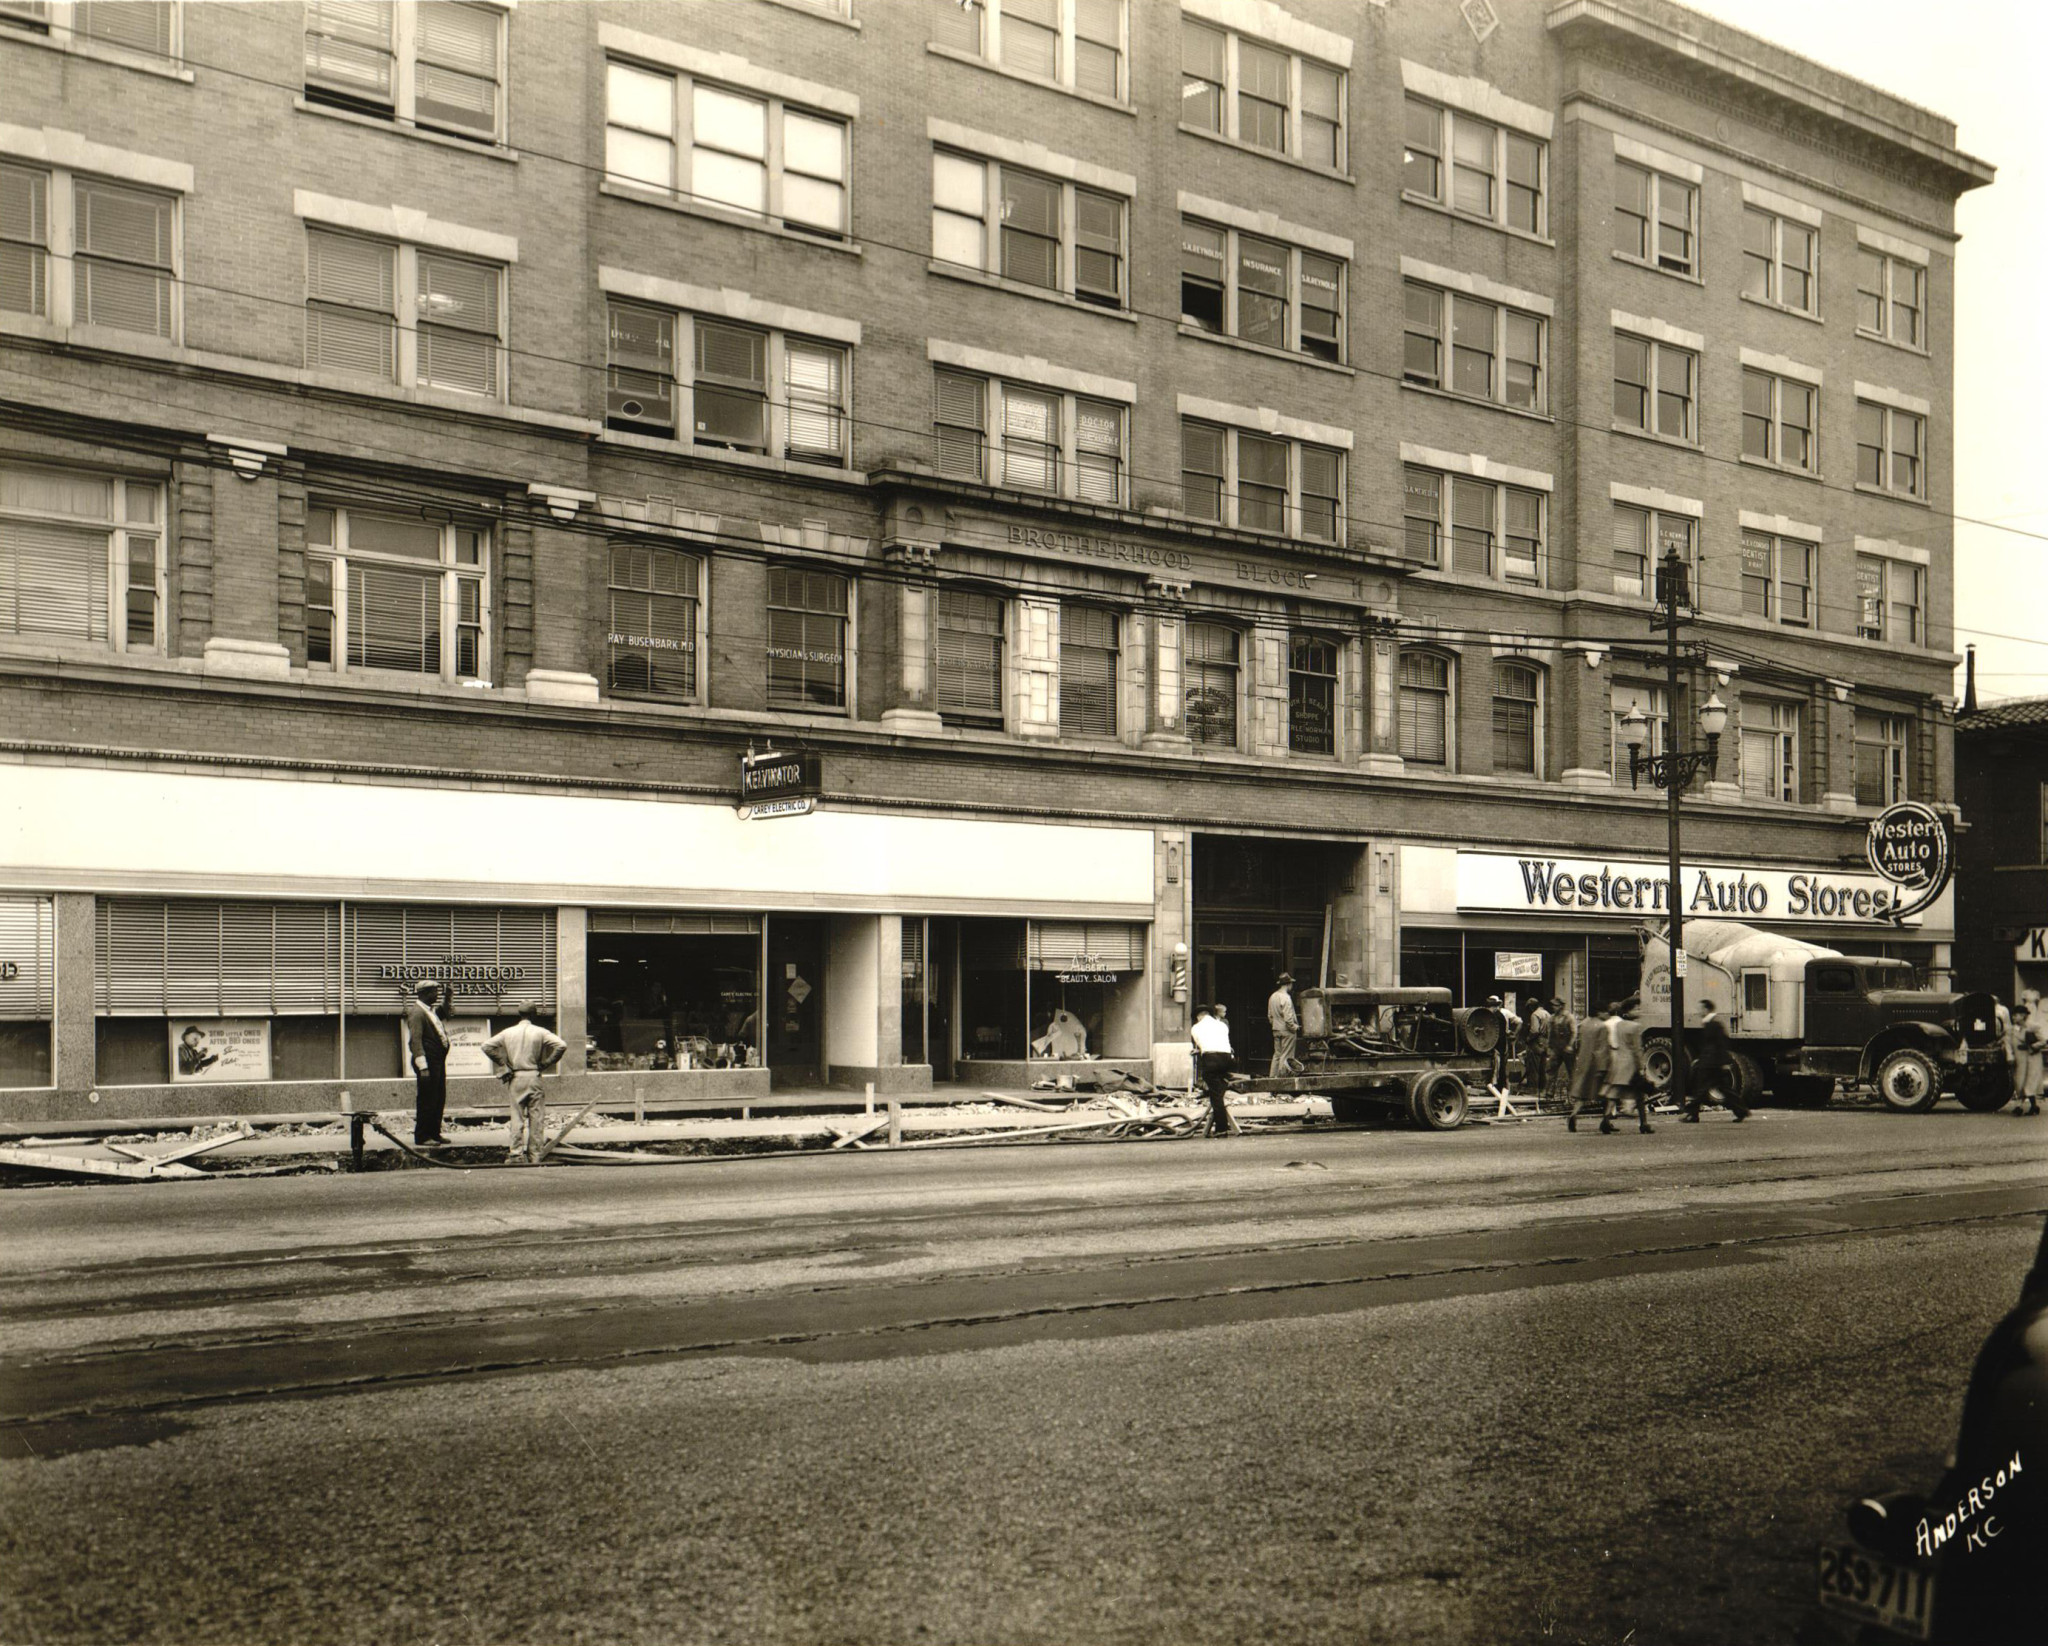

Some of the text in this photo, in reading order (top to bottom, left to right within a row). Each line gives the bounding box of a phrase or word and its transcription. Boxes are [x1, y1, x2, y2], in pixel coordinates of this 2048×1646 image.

[1242, 258, 1282, 276] INSURANCE
[1081, 415, 1115, 431] DOCTOR
[1007, 525, 1313, 590] BROTHERHOOD BLOCK
[1742, 548, 1767, 561] DENTIST
[607, 632, 625, 645] RAY
[1295, 711, 1320, 721] SHOPPE
[1305, 726, 1333, 735] NORMAN
[1295, 734, 1320, 744] STUDIO
[745, 764, 800, 790] KELVINATOR
[753, 803, 771, 815] CAREY
[772, 801, 797, 813] ELECTRIC
[1869, 819, 1944, 839] Western
[1883, 841, 1931, 860] Auto
[1887, 861, 1922, 872] STORES
[1519, 860, 1889, 917] Western Auto Stores
[2031, 929, 2048, 958] K
[441, 954, 467, 964] THE
[1084, 952, 1100, 963] THE
[380, 964, 525, 980] BROTHERHOOD
[1060, 974, 1117, 983] BEAUTY SALON
[460, 982, 508, 995] BANK
